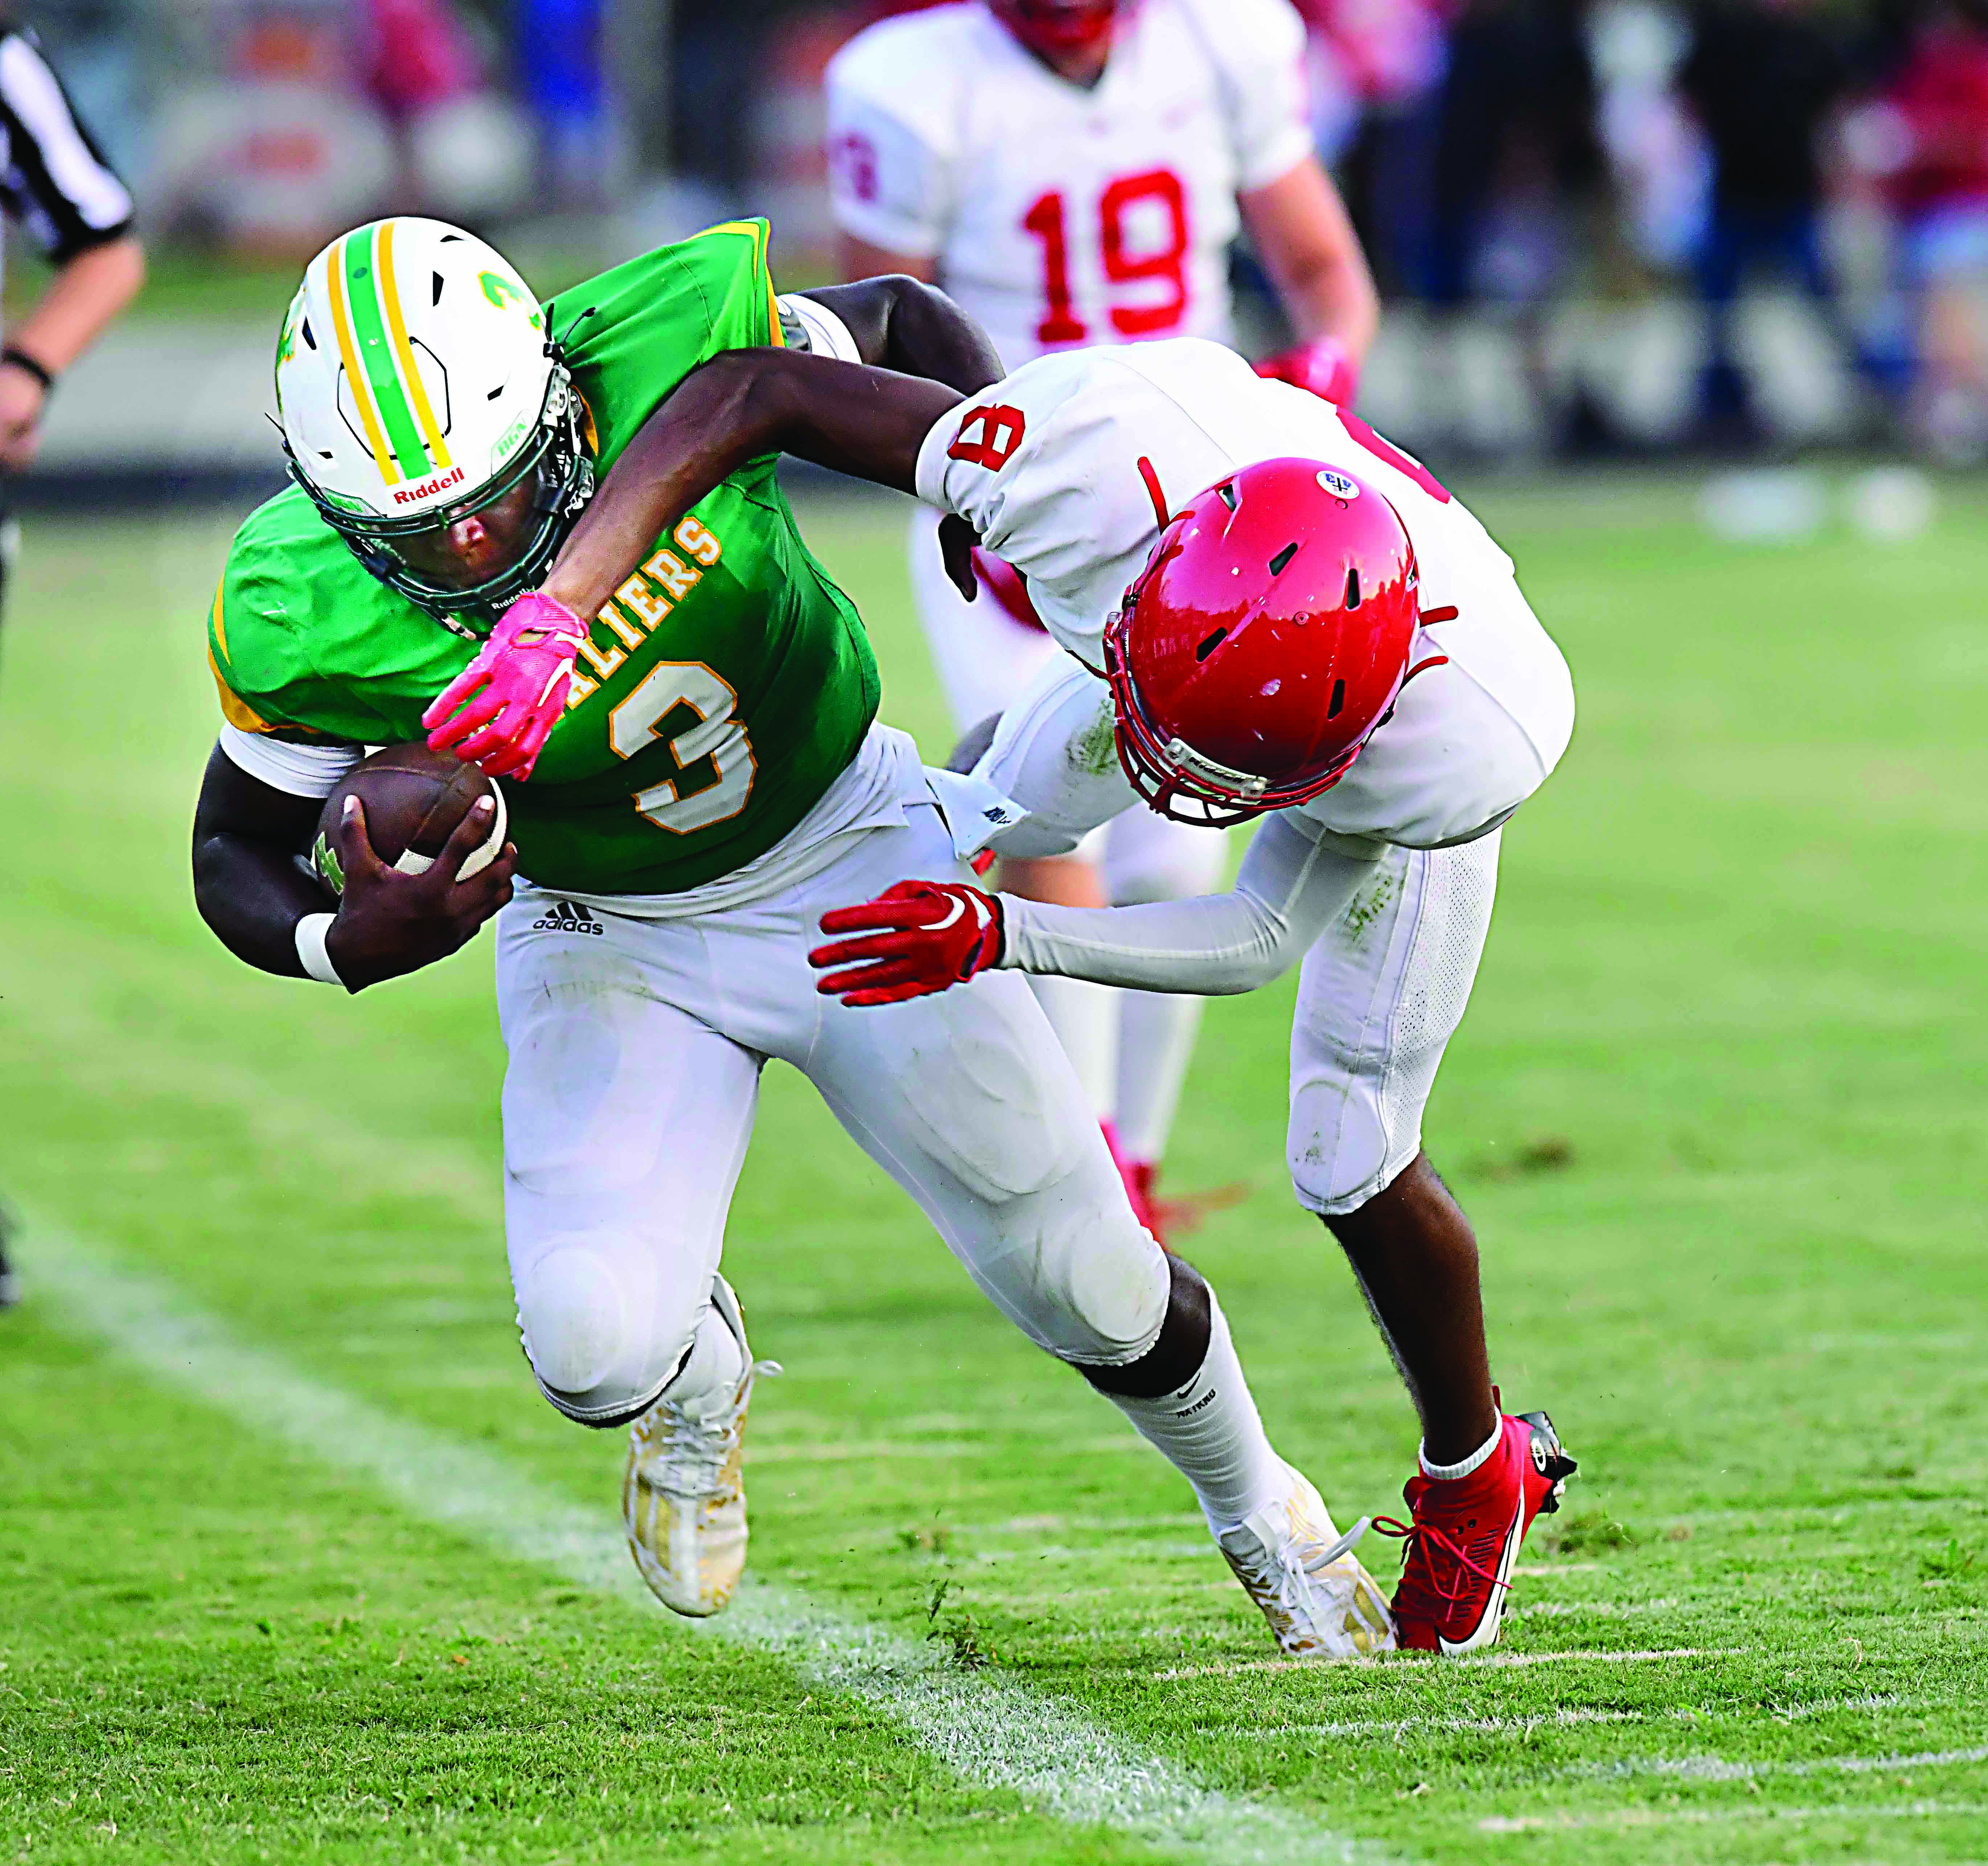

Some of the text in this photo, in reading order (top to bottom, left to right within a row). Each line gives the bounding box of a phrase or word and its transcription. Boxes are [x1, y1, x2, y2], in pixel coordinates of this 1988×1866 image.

[1024, 170, 1187, 343] 19
[394, 467, 465, 504] Riddell
[947, 403, 1026, 472] 8
[554, 517, 722, 723] ALIERS
[608, 660, 759, 835] 3
[533, 917, 603, 935] adidas
